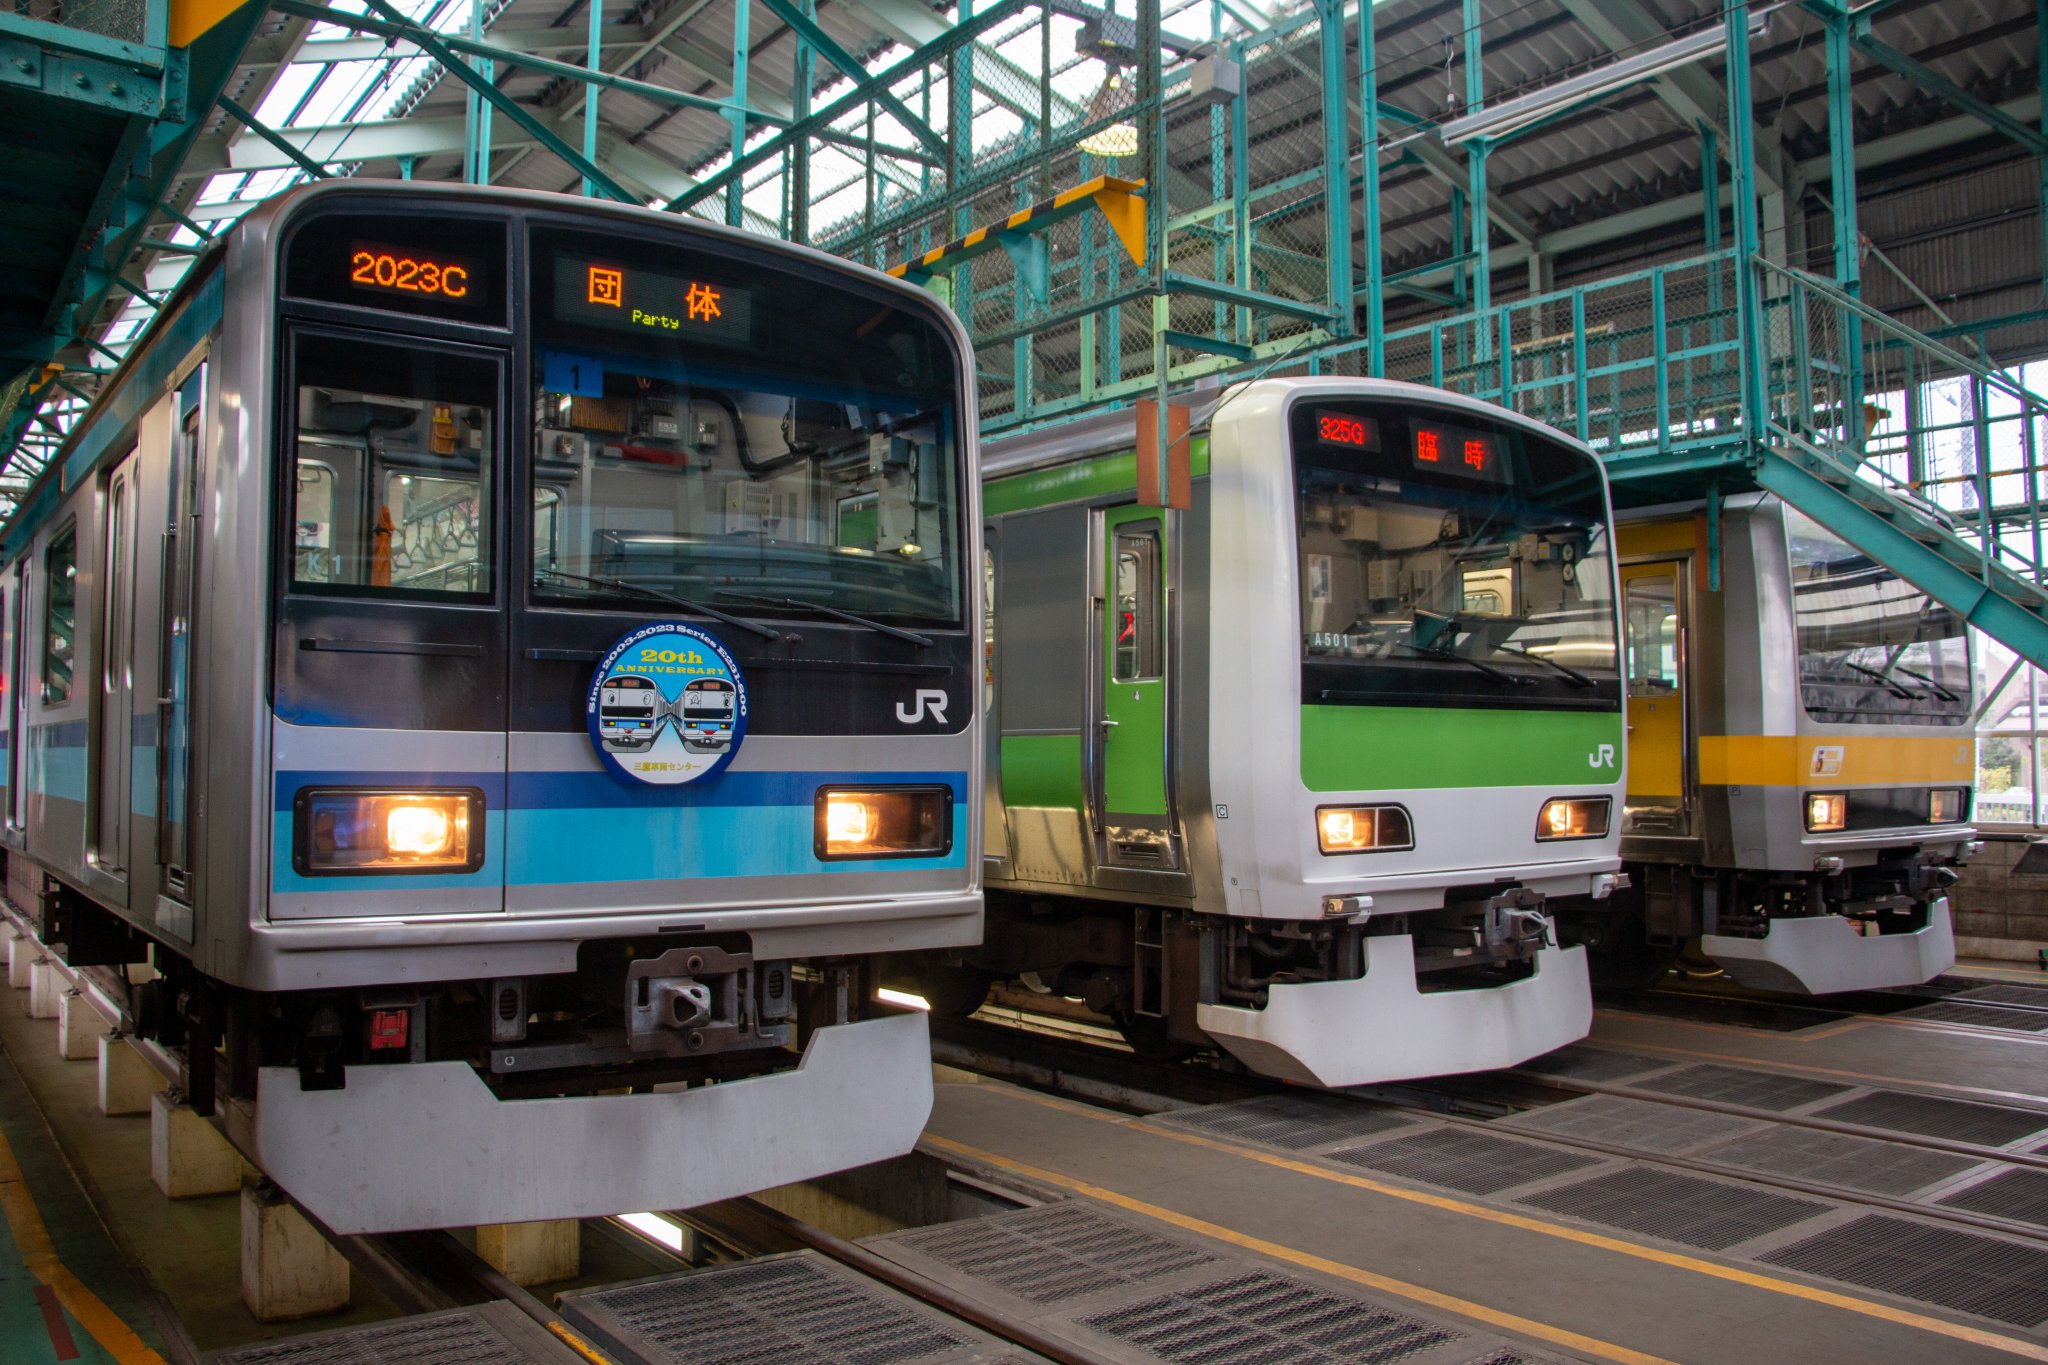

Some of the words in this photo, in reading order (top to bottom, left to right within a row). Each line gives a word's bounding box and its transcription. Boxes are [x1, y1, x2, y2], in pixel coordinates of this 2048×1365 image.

[351, 251, 467, 297] 2023C
[633, 309, 680, 330] Party
[570, 364, 580, 391] 1
[1320, 416, 1364, 446] 325G
[1314, 632, 1348, 648] A501
[588, 670, 606, 713] Since
[602, 624, 675, 671] 2003-2023
[676, 625, 718, 650] Series
[640, 649, 703, 664] 20th
[615, 665, 726, 675] ANNIVERSARY
[896, 688, 948, 724] JR
[1588, 743, 1615, 768] JR
[1953, 746, 1969, 765] JR
